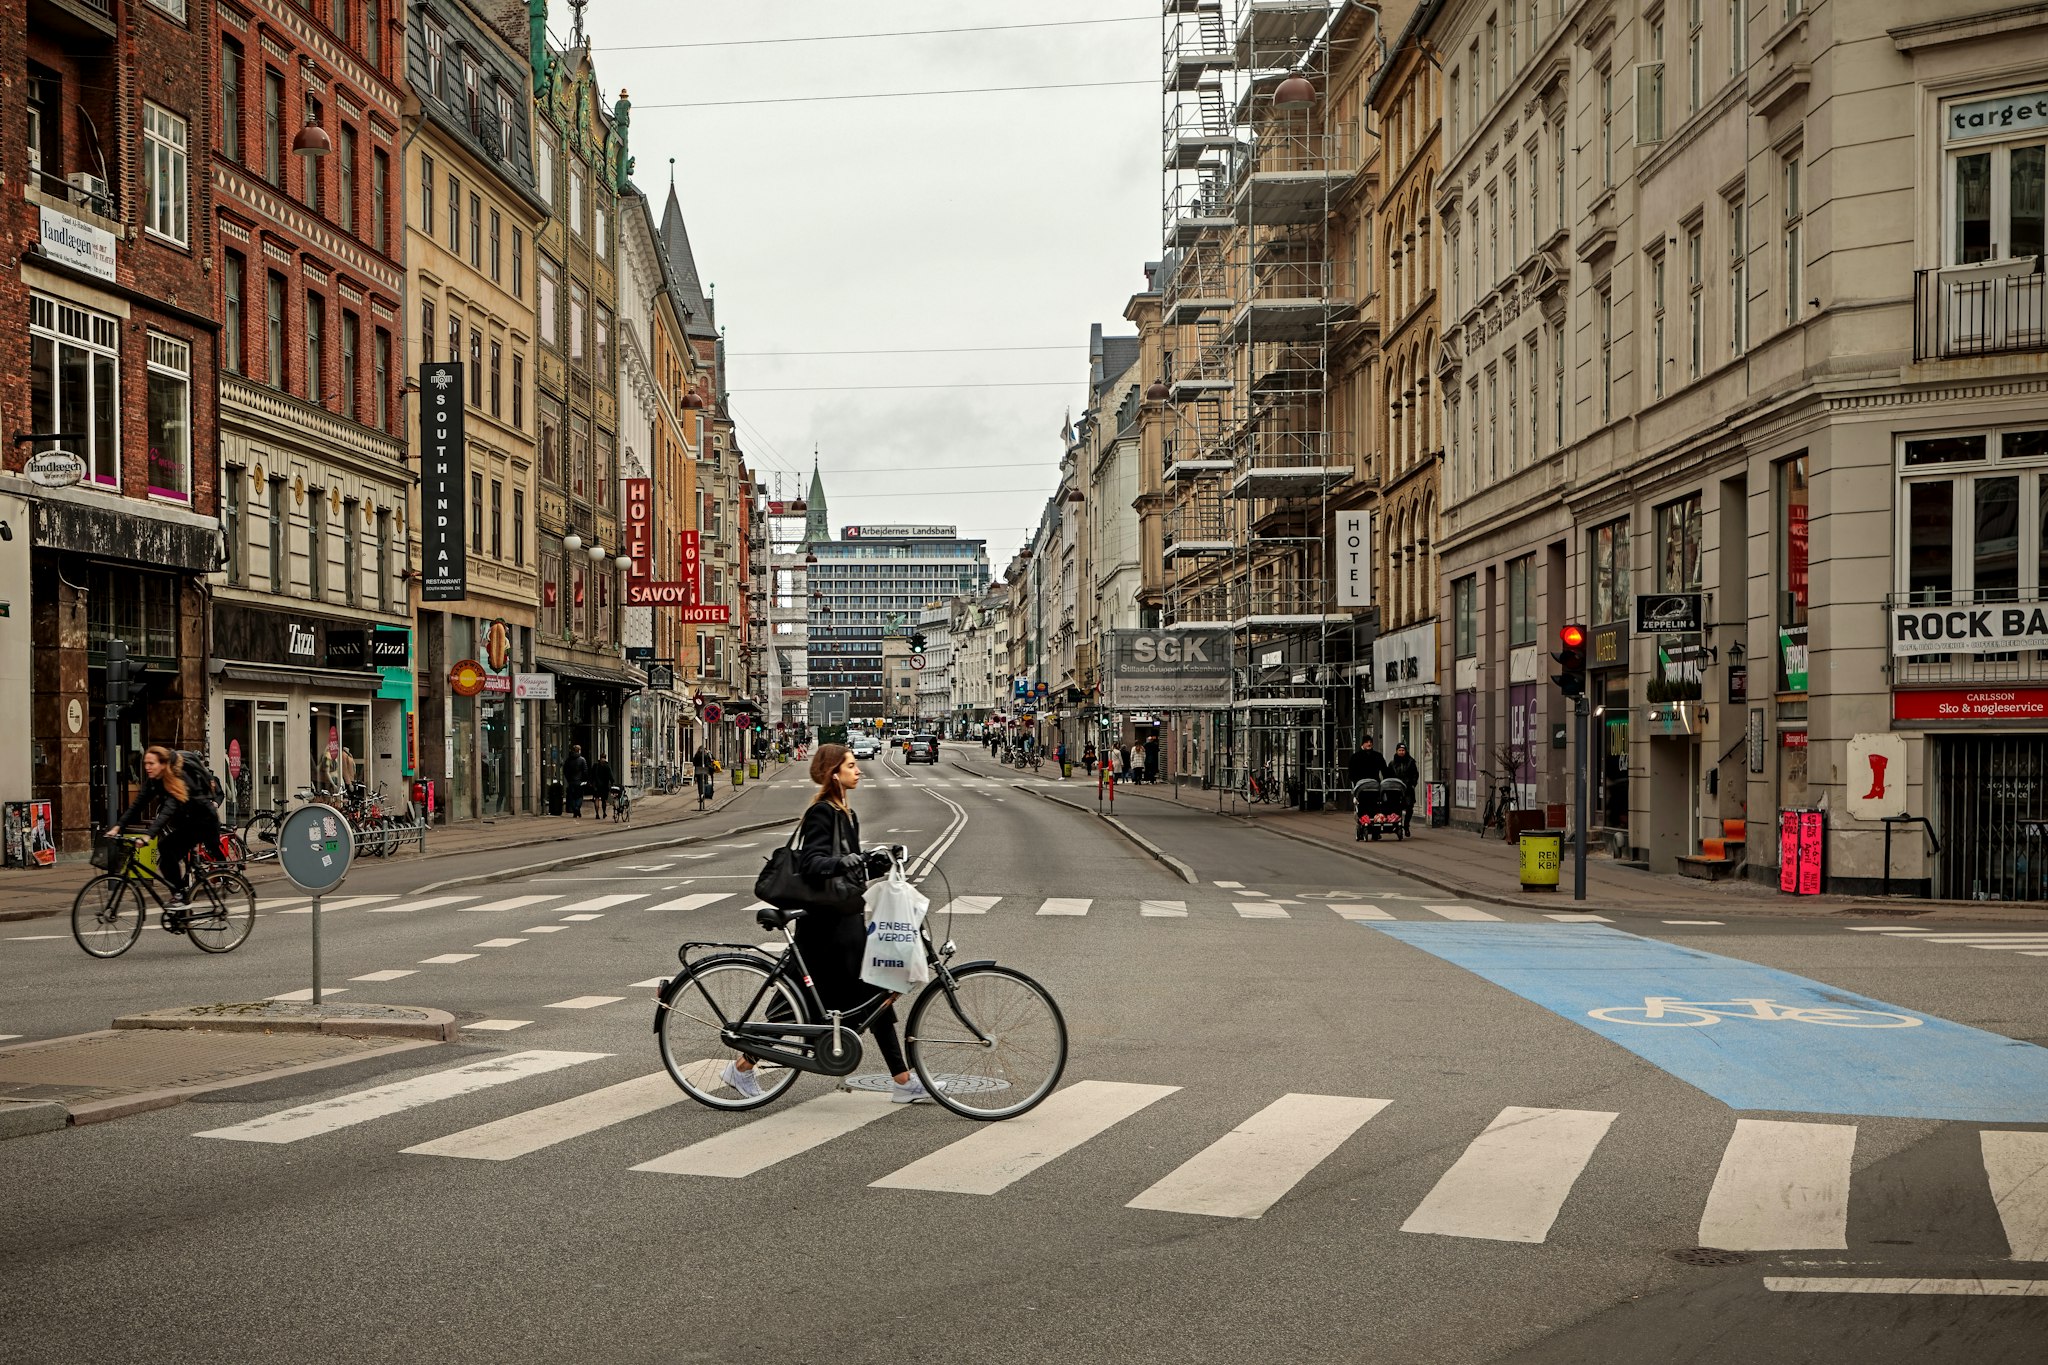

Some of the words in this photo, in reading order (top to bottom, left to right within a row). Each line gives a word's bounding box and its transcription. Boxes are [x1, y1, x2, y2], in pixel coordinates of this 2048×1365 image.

[1954, 101, 2047, 129] target
[42, 219, 92, 257] Tandlægen
[28, 461, 82, 473] Tandlægen
[630, 484, 645, 577] HOTEL
[861, 527, 909, 537] Arbejdernes
[912, 527, 955, 535] Landsbank
[1347, 519, 1360, 597] HOTEL
[630, 586, 686, 603] SAVOY
[684, 608, 728, 621] HOTEL
[1642, 620, 1687, 629] ZEPPELIN
[1897, 610, 1993, 641] ROCK
[375, 642, 405, 655] Zizzi
[1134, 636, 1209, 663] SGK
[2001, 639, 2020, 648] BEER
[1120, 664, 1181, 674] StilladsGruppen
[1967, 692, 2015, 702] CARLSSON
[1939, 703, 1960, 714] Sko
[1962, 704, 1971, 714] &
[1973, 702, 2044, 716] nøgleservice
[1538, 851, 1558, 859] REN
[1538, 861, 1558, 869] KBH
[872, 957, 905, 968] Irma
